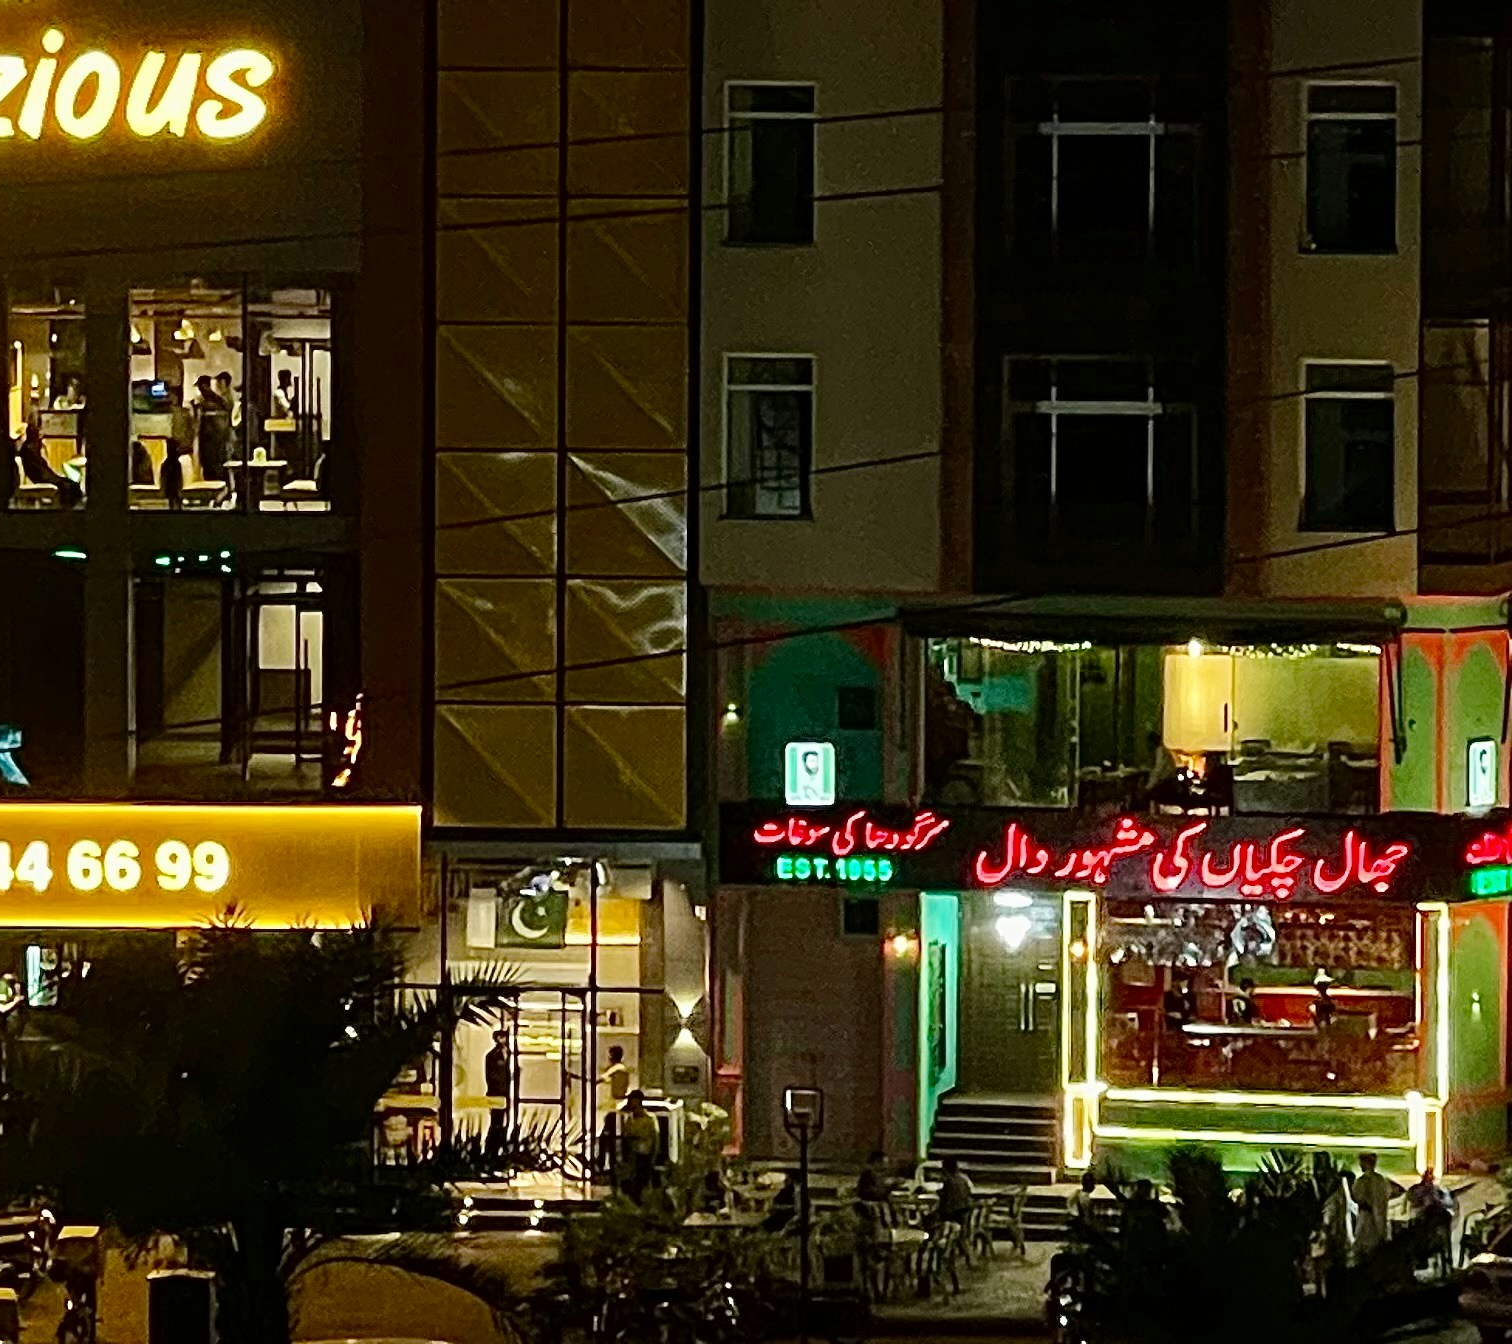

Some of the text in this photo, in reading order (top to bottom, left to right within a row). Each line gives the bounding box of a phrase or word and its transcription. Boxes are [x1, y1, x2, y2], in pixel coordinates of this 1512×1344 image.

[831, 810, 867, 856] کی
[975, 823, 1049, 884] دال
[1053, 818, 1155, 884] مشہور
[1152, 821, 1207, 892] کی
[1313, 830, 1409, 893] جھال
[65, 838, 142, 893] 66
[154, 839, 231, 894] 99
